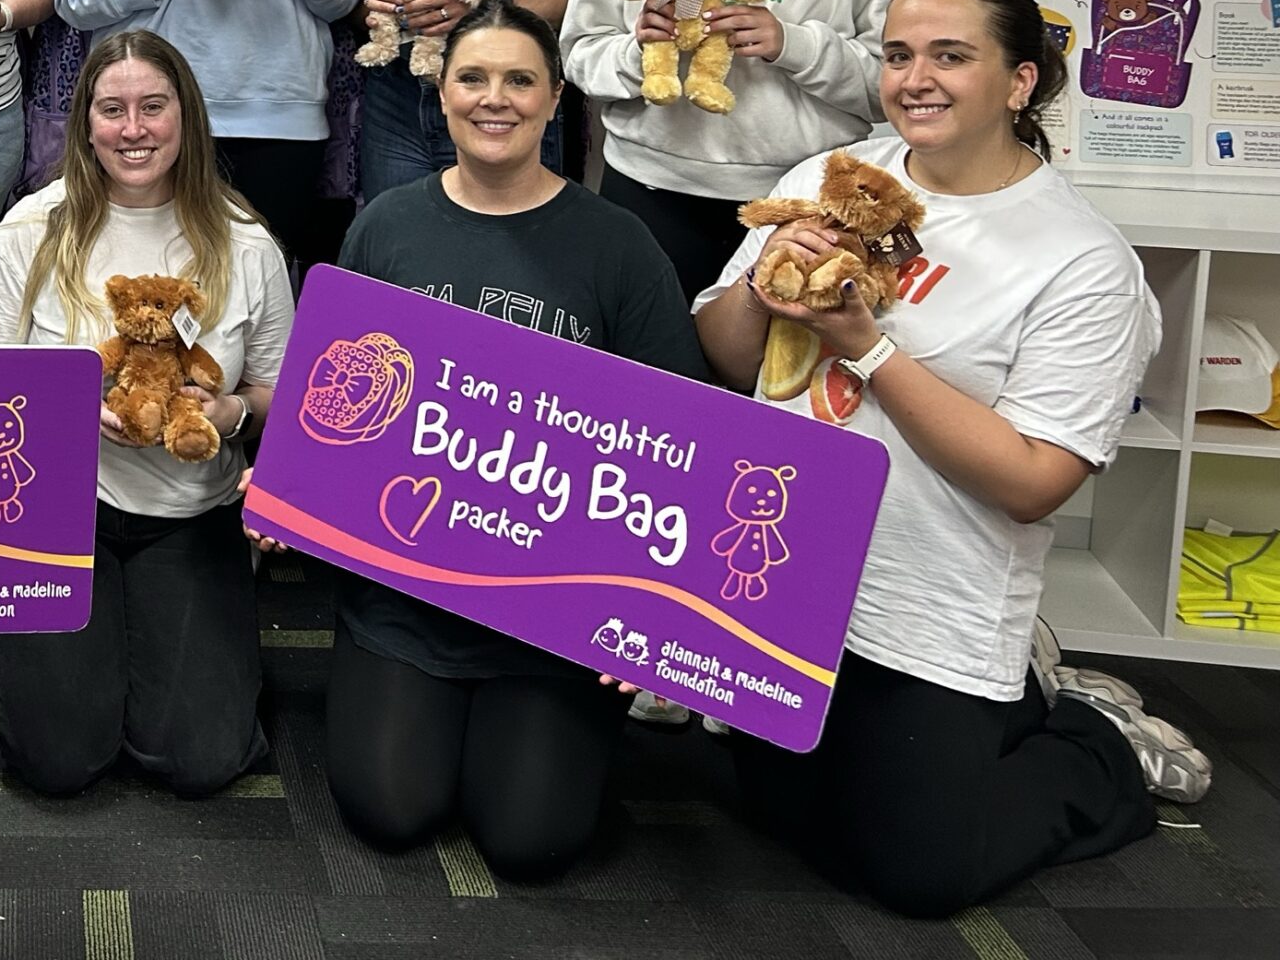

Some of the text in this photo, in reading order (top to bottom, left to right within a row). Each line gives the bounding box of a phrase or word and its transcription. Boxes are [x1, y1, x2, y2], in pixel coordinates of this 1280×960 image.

[1123, 65, 1155, 76] BUDDY
[1127, 76, 1148, 86] BAG
[1206, 356, 1242, 365] WARDEN
[434, 358, 697, 473] I am a thoughtful
[411, 401, 689, 567] Buddy Bag
[447, 499, 543, 550] packer
[0, 586, 11, 598] &
[12, 581, 72, 599] madeline
[654, 658, 735, 707] foundation
[660, 640, 804, 709] alannah & madeline
